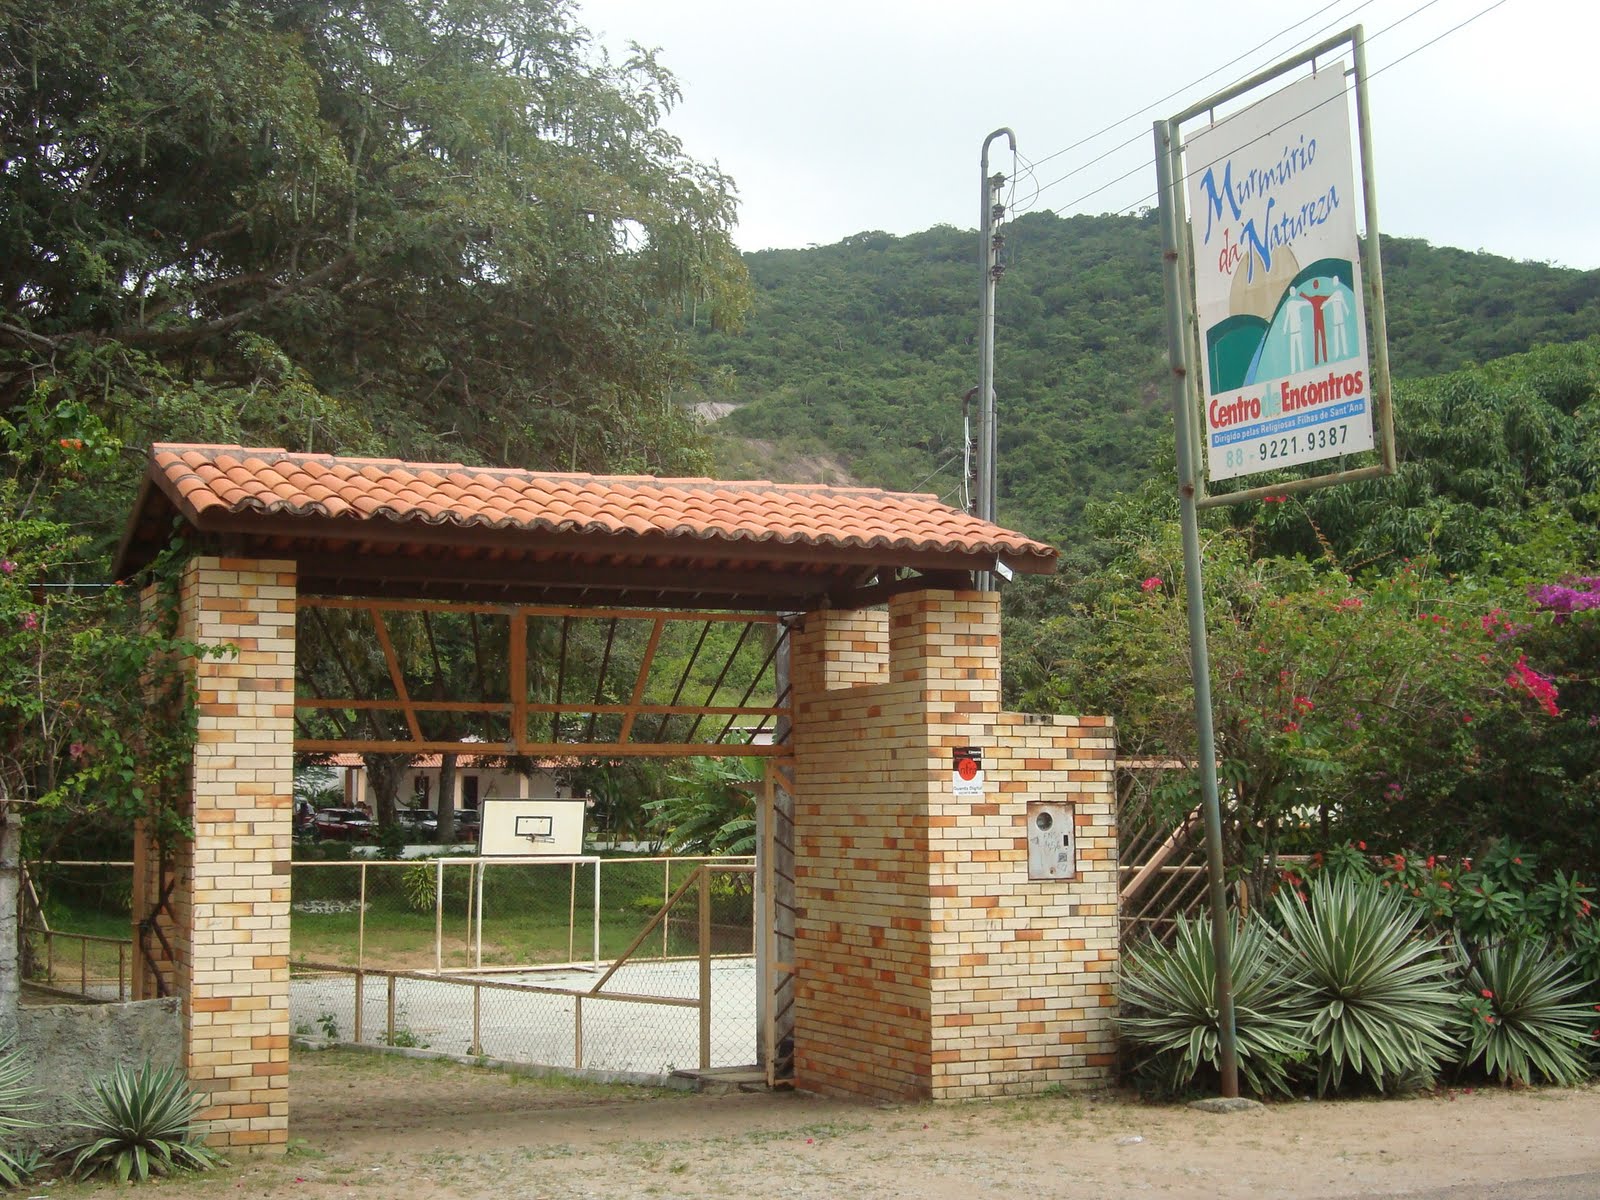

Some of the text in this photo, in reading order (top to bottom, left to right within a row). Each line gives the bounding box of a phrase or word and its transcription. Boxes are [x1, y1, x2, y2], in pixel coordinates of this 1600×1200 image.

[1200, 134, 1317, 245] Murmúrio
[1219, 185, 1340, 284] da Natureza
[1209, 370, 1364, 428] Centro de Encontros
[1214, 402, 1364, 444] Dirigido pelas Religiosas Filhas de Sant'Ana
[1226, 447, 1244, 469] 88
[1259, 424, 1348, 461] 9221.9387
